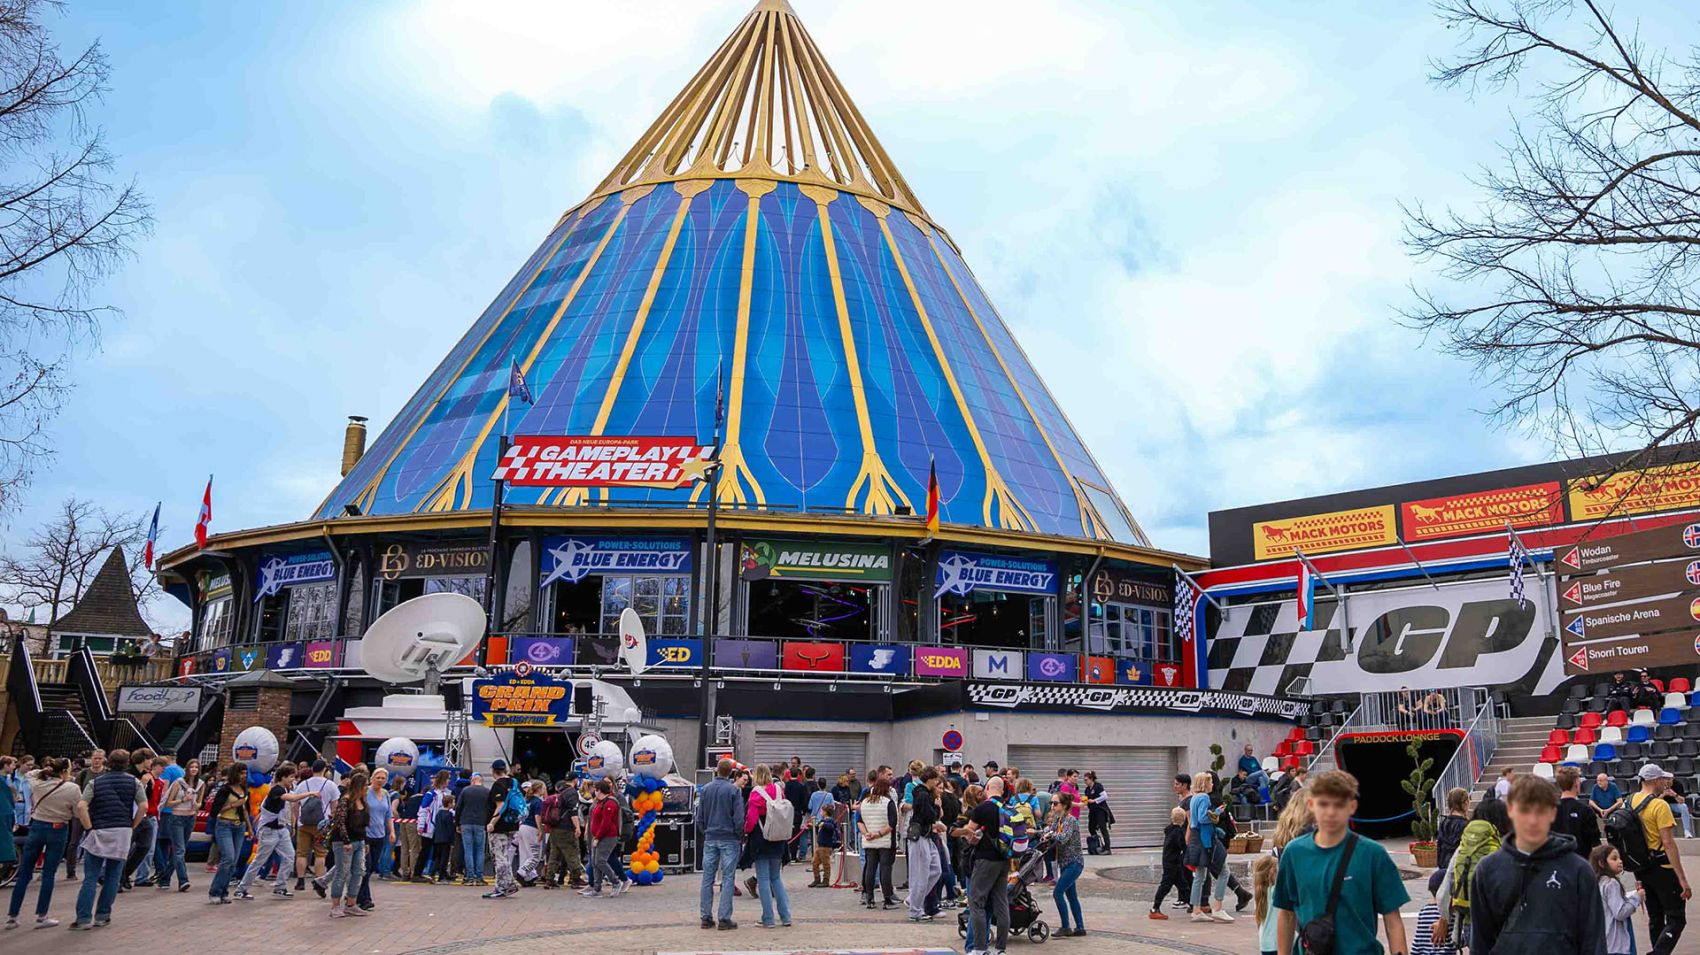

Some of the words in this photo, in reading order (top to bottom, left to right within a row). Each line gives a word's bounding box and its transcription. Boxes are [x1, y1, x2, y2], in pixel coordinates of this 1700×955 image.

[539, 446, 678, 461] GAMEPLAY
[532, 462, 670, 480] THEATER
[1441, 505, 1487, 522] MACK
[1487, 497, 1550, 516] MOTORS
[1289, 527, 1328, 542] MACK
[1329, 520, 1385, 537] MOTORS
[598, 541, 681, 550] POWER-SOLUTIONS
[1580, 546, 1611, 558] Wodan
[572, 552, 613, 567] BLUE
[616, 553, 685, 568] ENERGY
[777, 551, 889, 569] MELUSINA
[980, 558, 1047, 571] POWER-SOLUTIONS
[273, 567, 297, 581] BLUE
[959, 567, 993, 583] BLUE
[996, 570, 1050, 589] ENERGY
[1582, 583, 1602, 593] Blue
[1604, 580, 1621, 589] Fire
[1585, 612, 1631, 627] Spanische
[1633, 609, 1660, 620] Arena
[1357, 598, 1537, 674] GP
[312, 650, 331, 663] EDD
[1588, 647, 1615, 659] Snorri
[1616, 645, 1649, 656] Touren
[928, 655, 961, 669] EDDA
[478, 685, 566, 699] GRAND
[991, 688, 1017, 699] GP
[1089, 691, 1113, 702] GP
[1180, 694, 1200, 704] GP
[490, 698, 552, 712] PRIX
[1241, 699, 1253, 709] GP
[1284, 703, 1295, 713] GP
[584, 740, 596, 749] 45
[1353, 734, 1400, 744] PADDOCK
